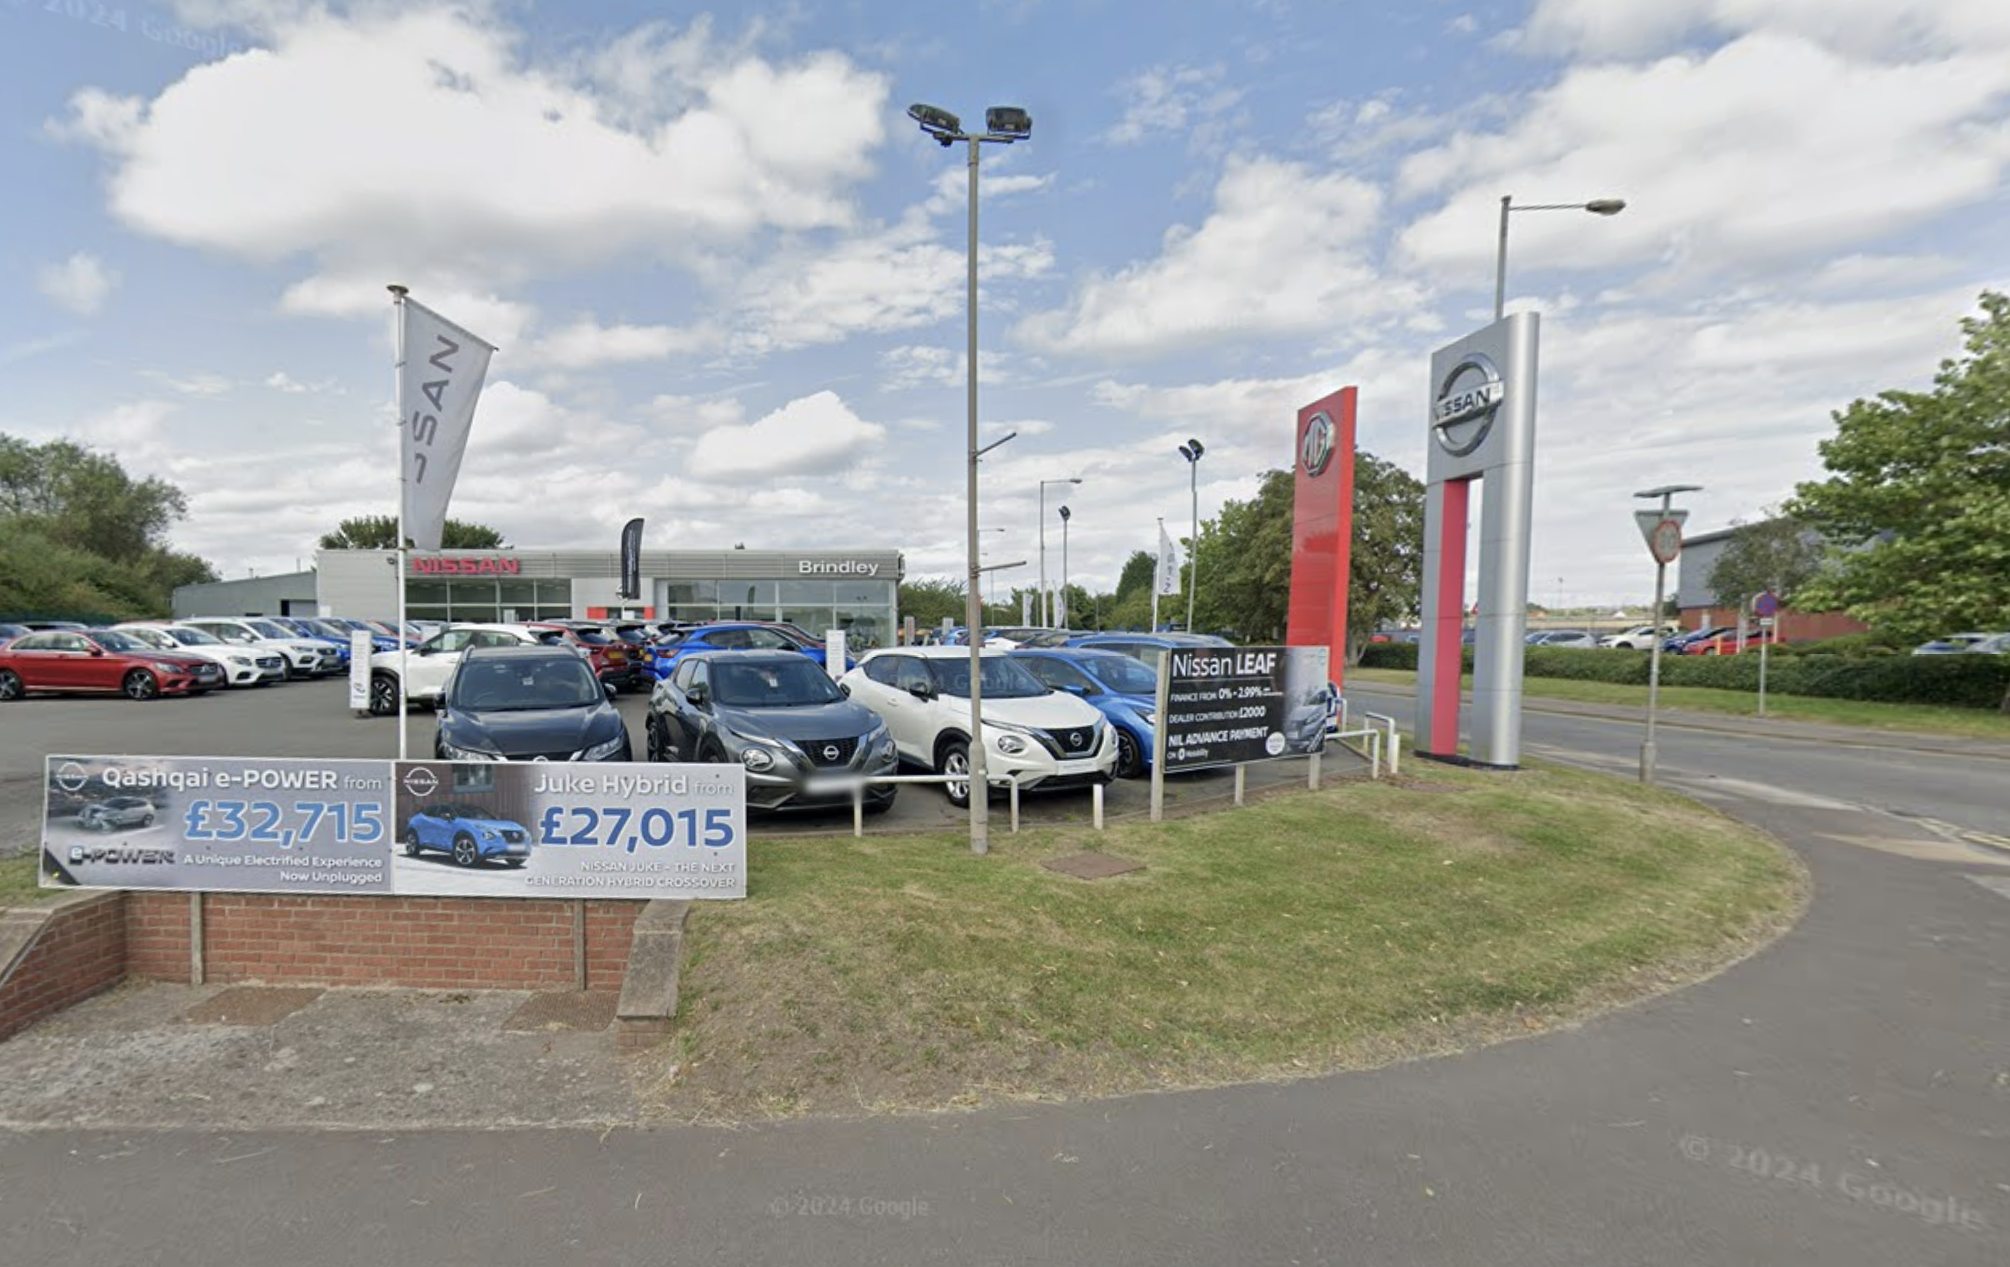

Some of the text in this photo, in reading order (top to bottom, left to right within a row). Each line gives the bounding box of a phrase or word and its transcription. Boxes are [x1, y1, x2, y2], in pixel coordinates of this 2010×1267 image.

[411, 556, 520, 575] NISSAN
[798, 560, 879, 577] Brindley
[1172, 653, 1277, 677] Nissan LEAF
[1168, 711, 1195, 724] DEALER
[1168, 726, 1269, 748] NIL ADVANCE PAYMENT
[101, 767, 382, 791] Qashqai e-POWER from
[534, 773, 734, 799] Juke Hybrid from
[184, 800, 384, 849] £32,715
[540, 806, 734, 853] £27,015
[184, 854, 382, 870] A Unique Electrified Experience
[581, 861, 627, 873] NISSAN
[629, 862, 662, 873] JUKE
[676, 862, 698, 873] THE
[702, 862, 735, 873] NEXT
[280, 870, 382, 885] Now Unplugged
[525, 875, 736, 888] GENERATION HYBRID CROSSOVER
